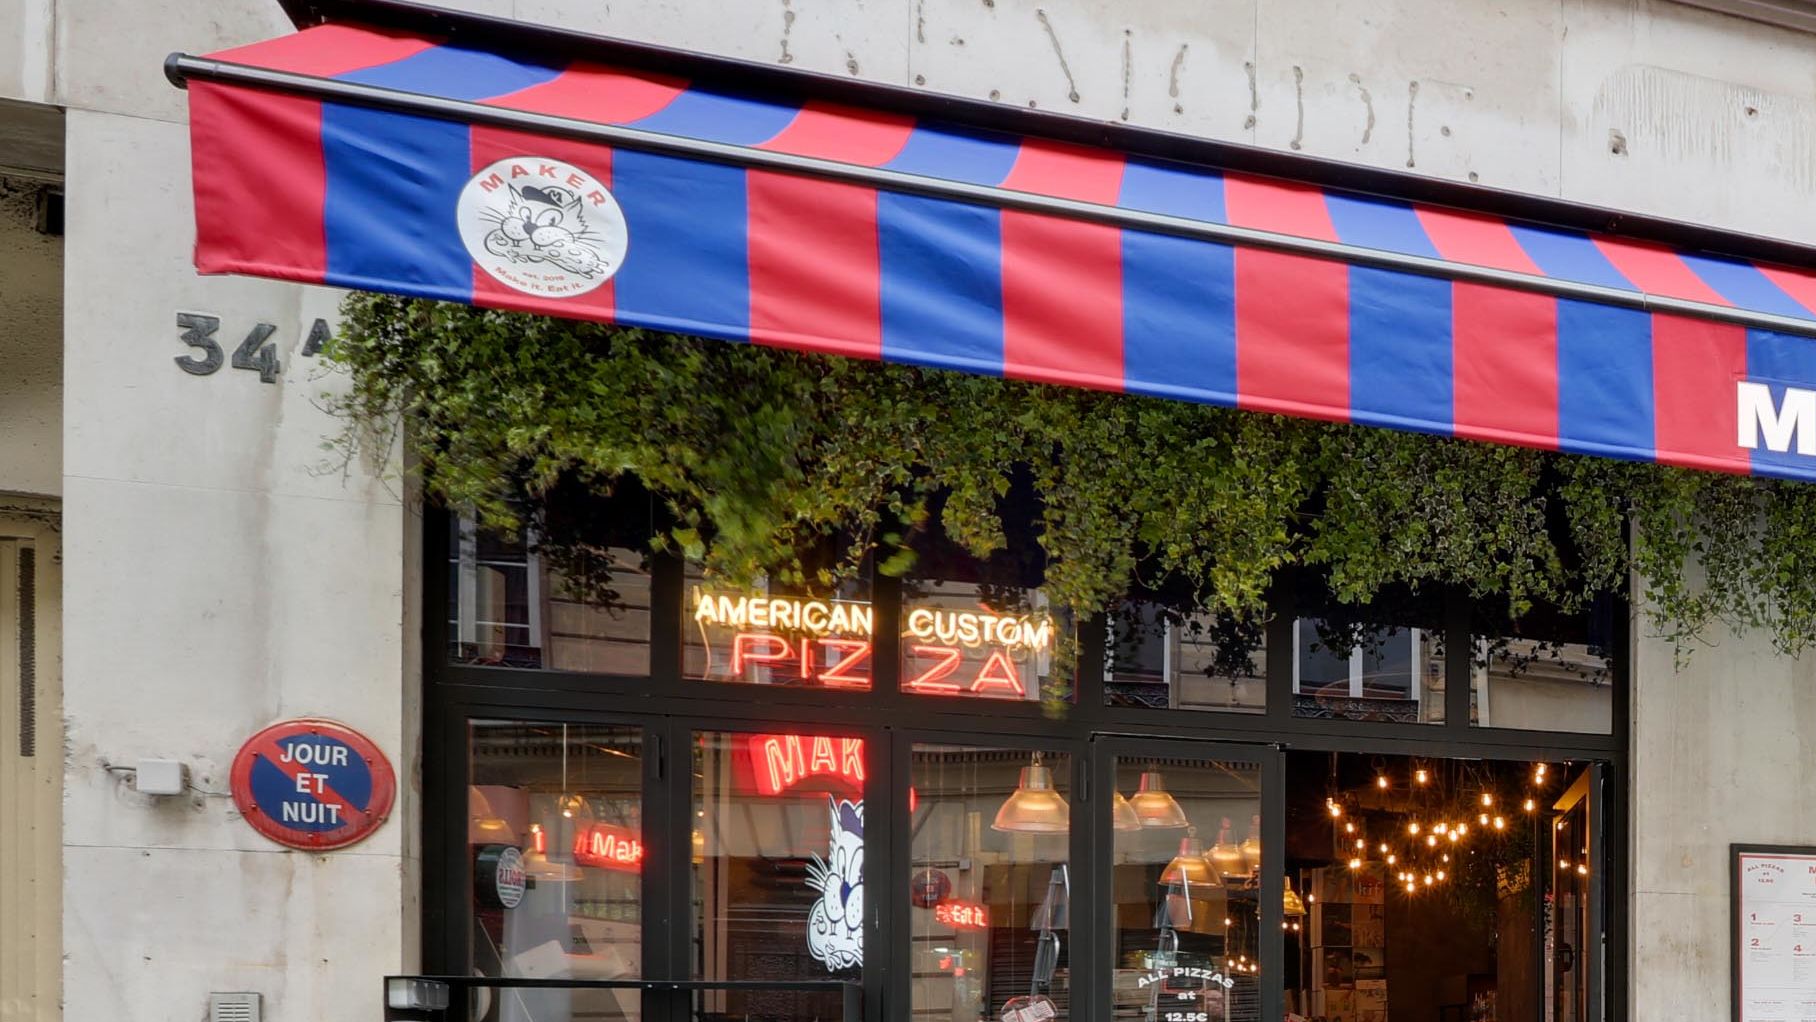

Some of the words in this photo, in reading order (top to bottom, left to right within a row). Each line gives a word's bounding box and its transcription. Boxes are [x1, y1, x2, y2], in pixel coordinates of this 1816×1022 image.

[479, 164, 606, 207] MAKER
[495, 266, 527, 287] Make
[174, 312, 280, 384] 34
[695, 594, 873, 636] AMERICAN
[909, 609, 1049, 648] CUSTOM
[732, 632, 1026, 696] PIZZA
[280, 743, 348, 766] JOUR
[296, 772, 329, 794] ET
[282, 801, 342, 824] NUIT
[1750, 913, 1756, 921] 1
[1793, 914, 1802, 922] 3
[1751, 938, 1760, 946] 2
[1793, 944, 1803, 952] 4
[1137, 968, 1169, 988] ALL
[1173, 967, 1235, 989] PIZZAS
[1177, 991, 1196, 1000] at
[1165, 1013, 1208, 1022] 12.5€
